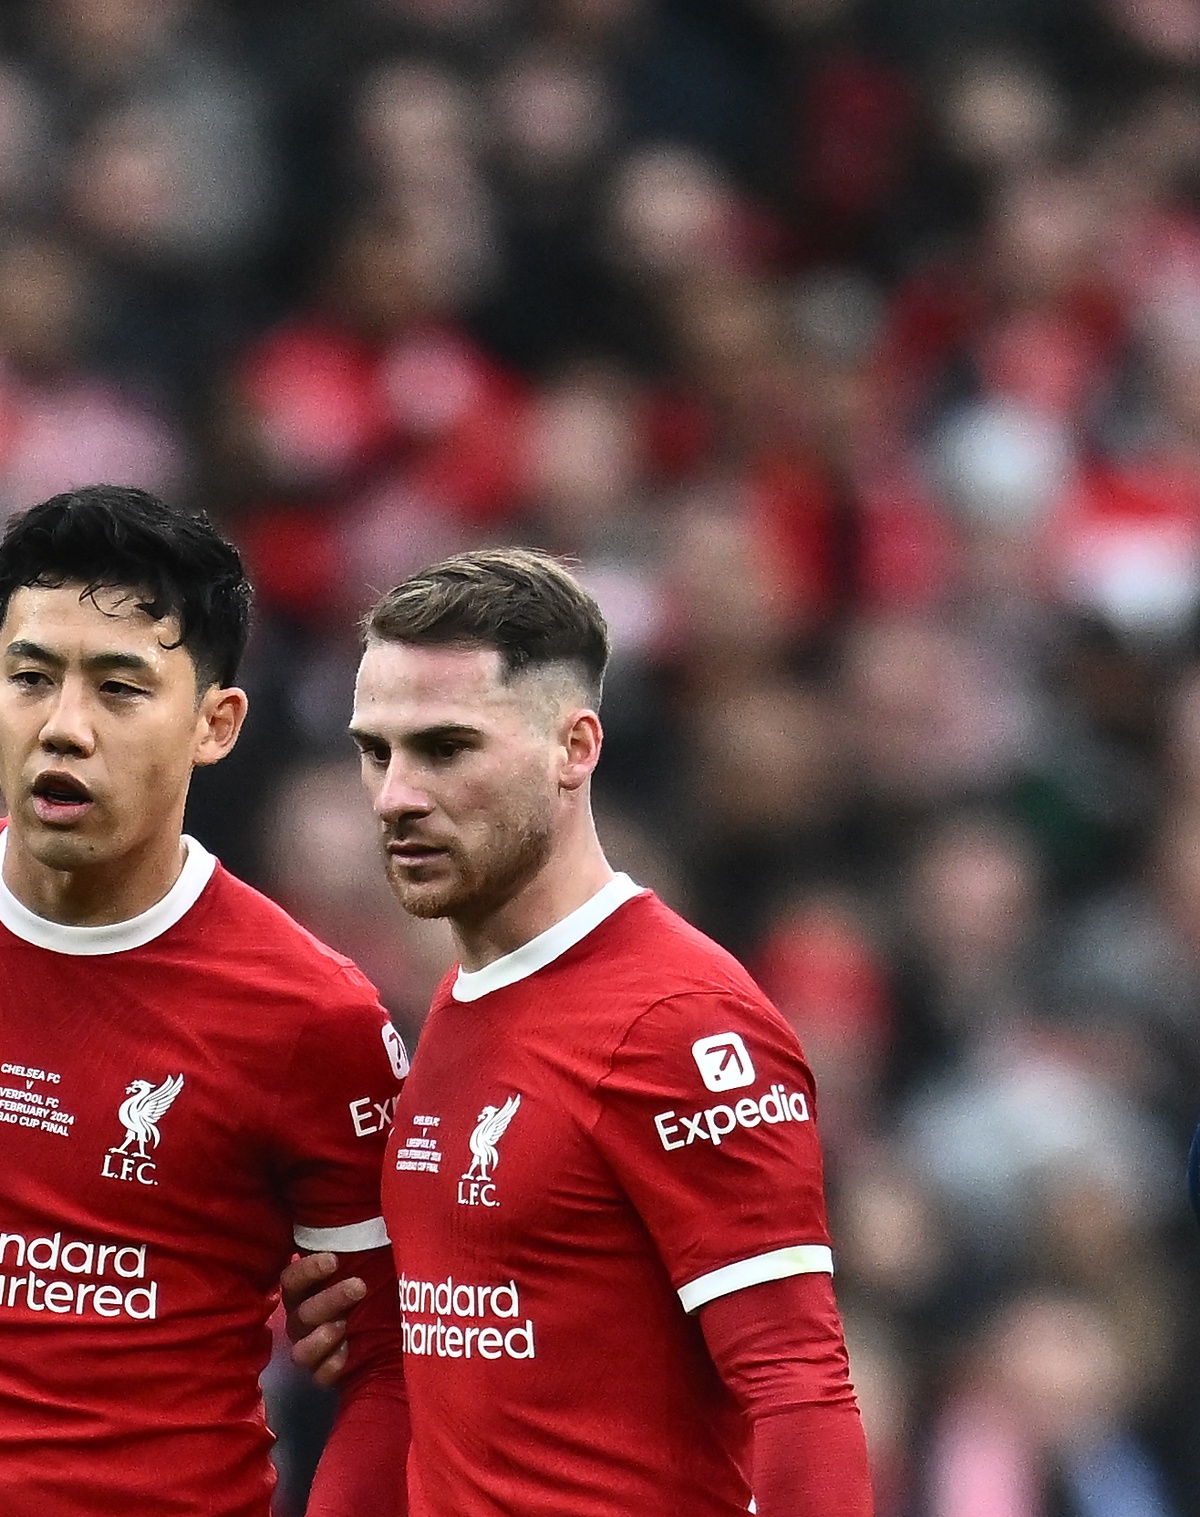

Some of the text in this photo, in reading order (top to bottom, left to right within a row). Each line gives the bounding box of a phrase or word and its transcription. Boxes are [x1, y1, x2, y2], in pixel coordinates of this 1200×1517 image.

[1, 1063, 61, 1084] CHELSEA FC
[26, 1080, 34, 1090] V
[45, 1097, 59, 1109] FC
[19, 1116, 40, 1128] CUP
[41, 1121, 69, 1137] FINAL
[50, 1111, 75, 1125] 2024
[654, 1084, 809, 1151] Expedia
[401, 1314, 536, 1360] hartered
